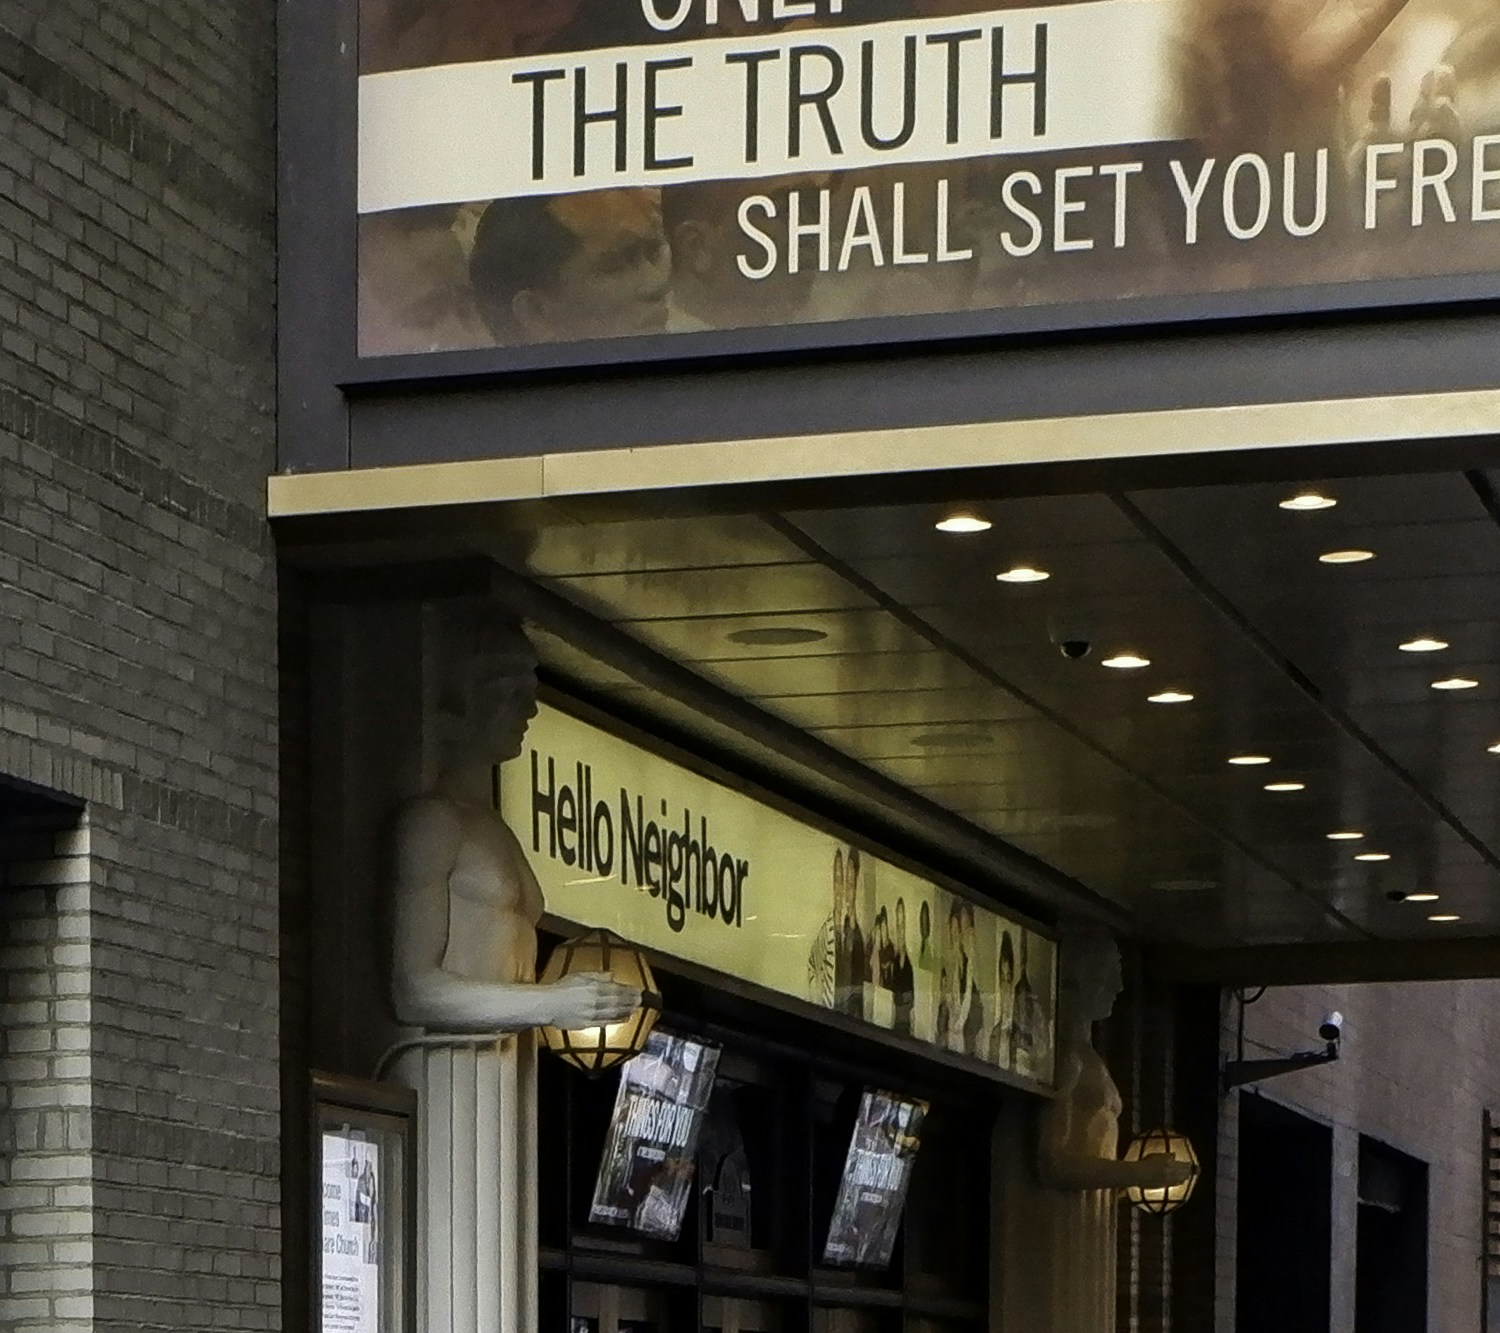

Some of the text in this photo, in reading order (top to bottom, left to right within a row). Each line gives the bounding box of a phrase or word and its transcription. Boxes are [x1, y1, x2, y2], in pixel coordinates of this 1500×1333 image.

[512, 23, 1050, 184] THE TRUTH
[735, 182, 975, 280] SHALL
[999, 162, 1147, 257] SET
[1164, 149, 1331, 244] YOU
[530, 749, 749, 932] Hello Neighbor
